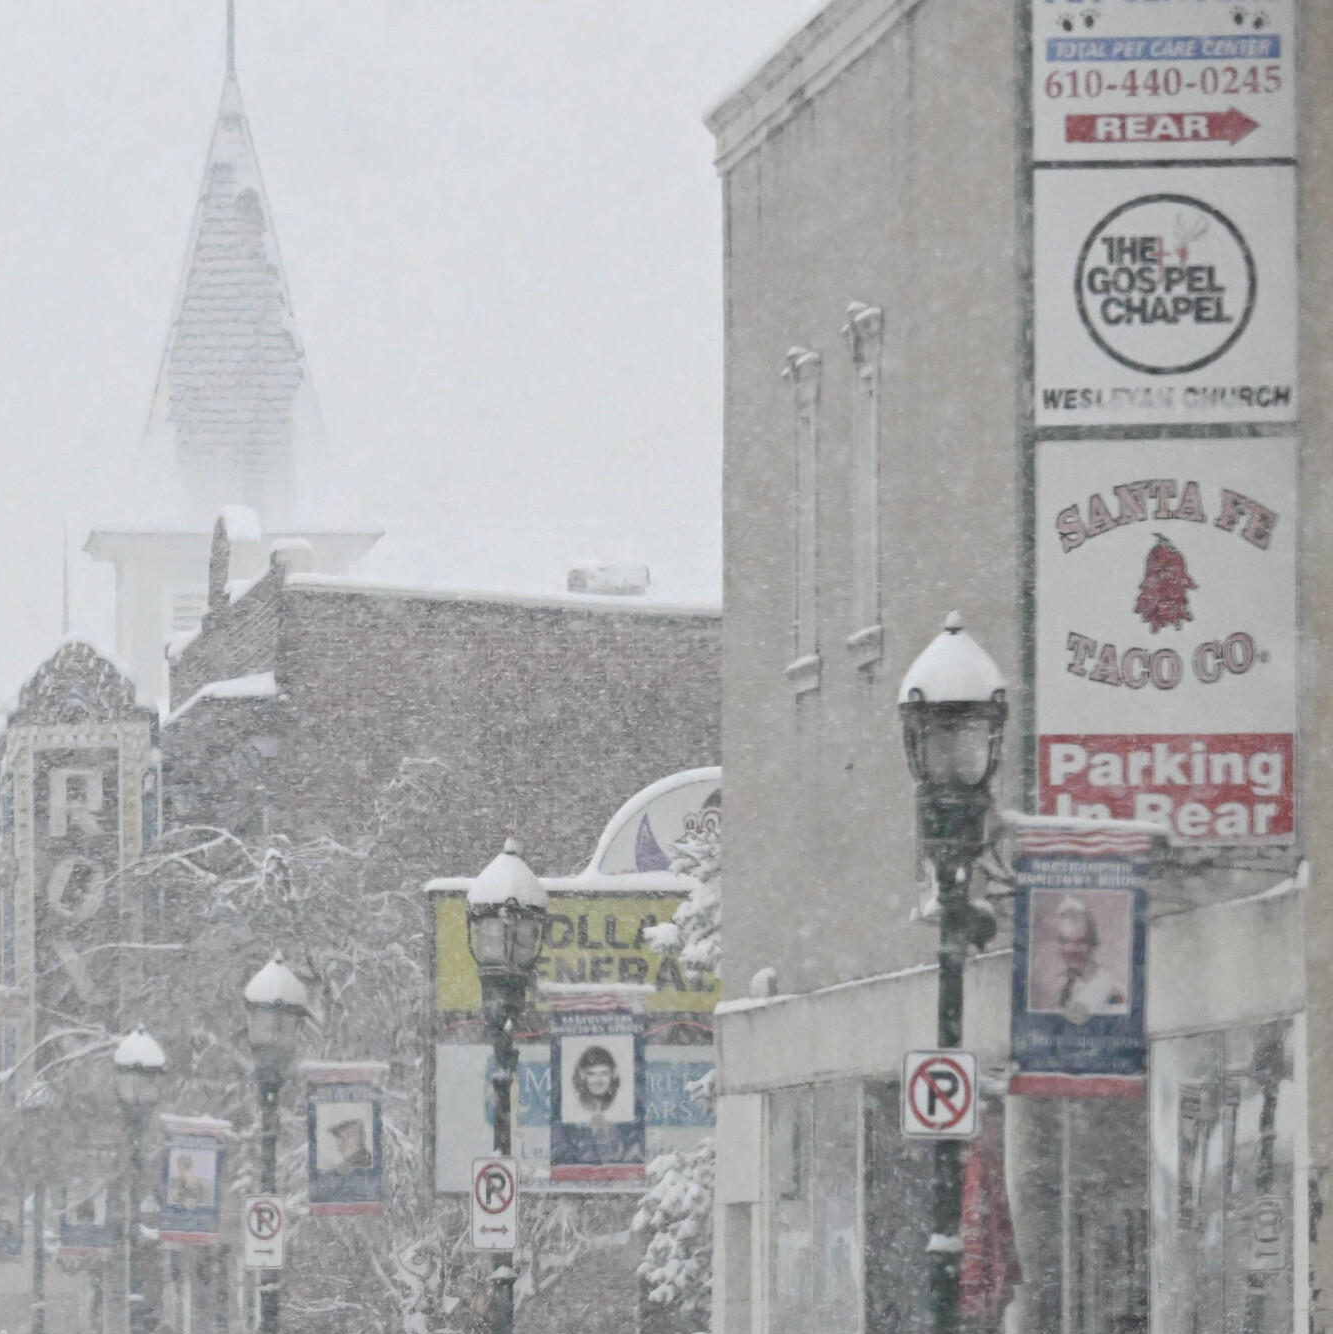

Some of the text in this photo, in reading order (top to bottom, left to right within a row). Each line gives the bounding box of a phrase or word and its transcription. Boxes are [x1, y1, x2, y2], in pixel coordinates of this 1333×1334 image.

[1055, 38, 1272, 59] TOTAL PET CARE CENTER
[1045, 65, 1282, 98] 610-440-0245
[1095, 115, 1210, 140] REAR
[1100, 236, 1158, 265] THE
[1087, 266, 1226, 295] GOSPEL
[1100, 297, 1233, 325] CHAPEL
[1056, 478, 1280, 554] SANTA FE
[1067, 631, 1271, 690] TACO CO.
[1049, 741, 1282, 796] Parking
